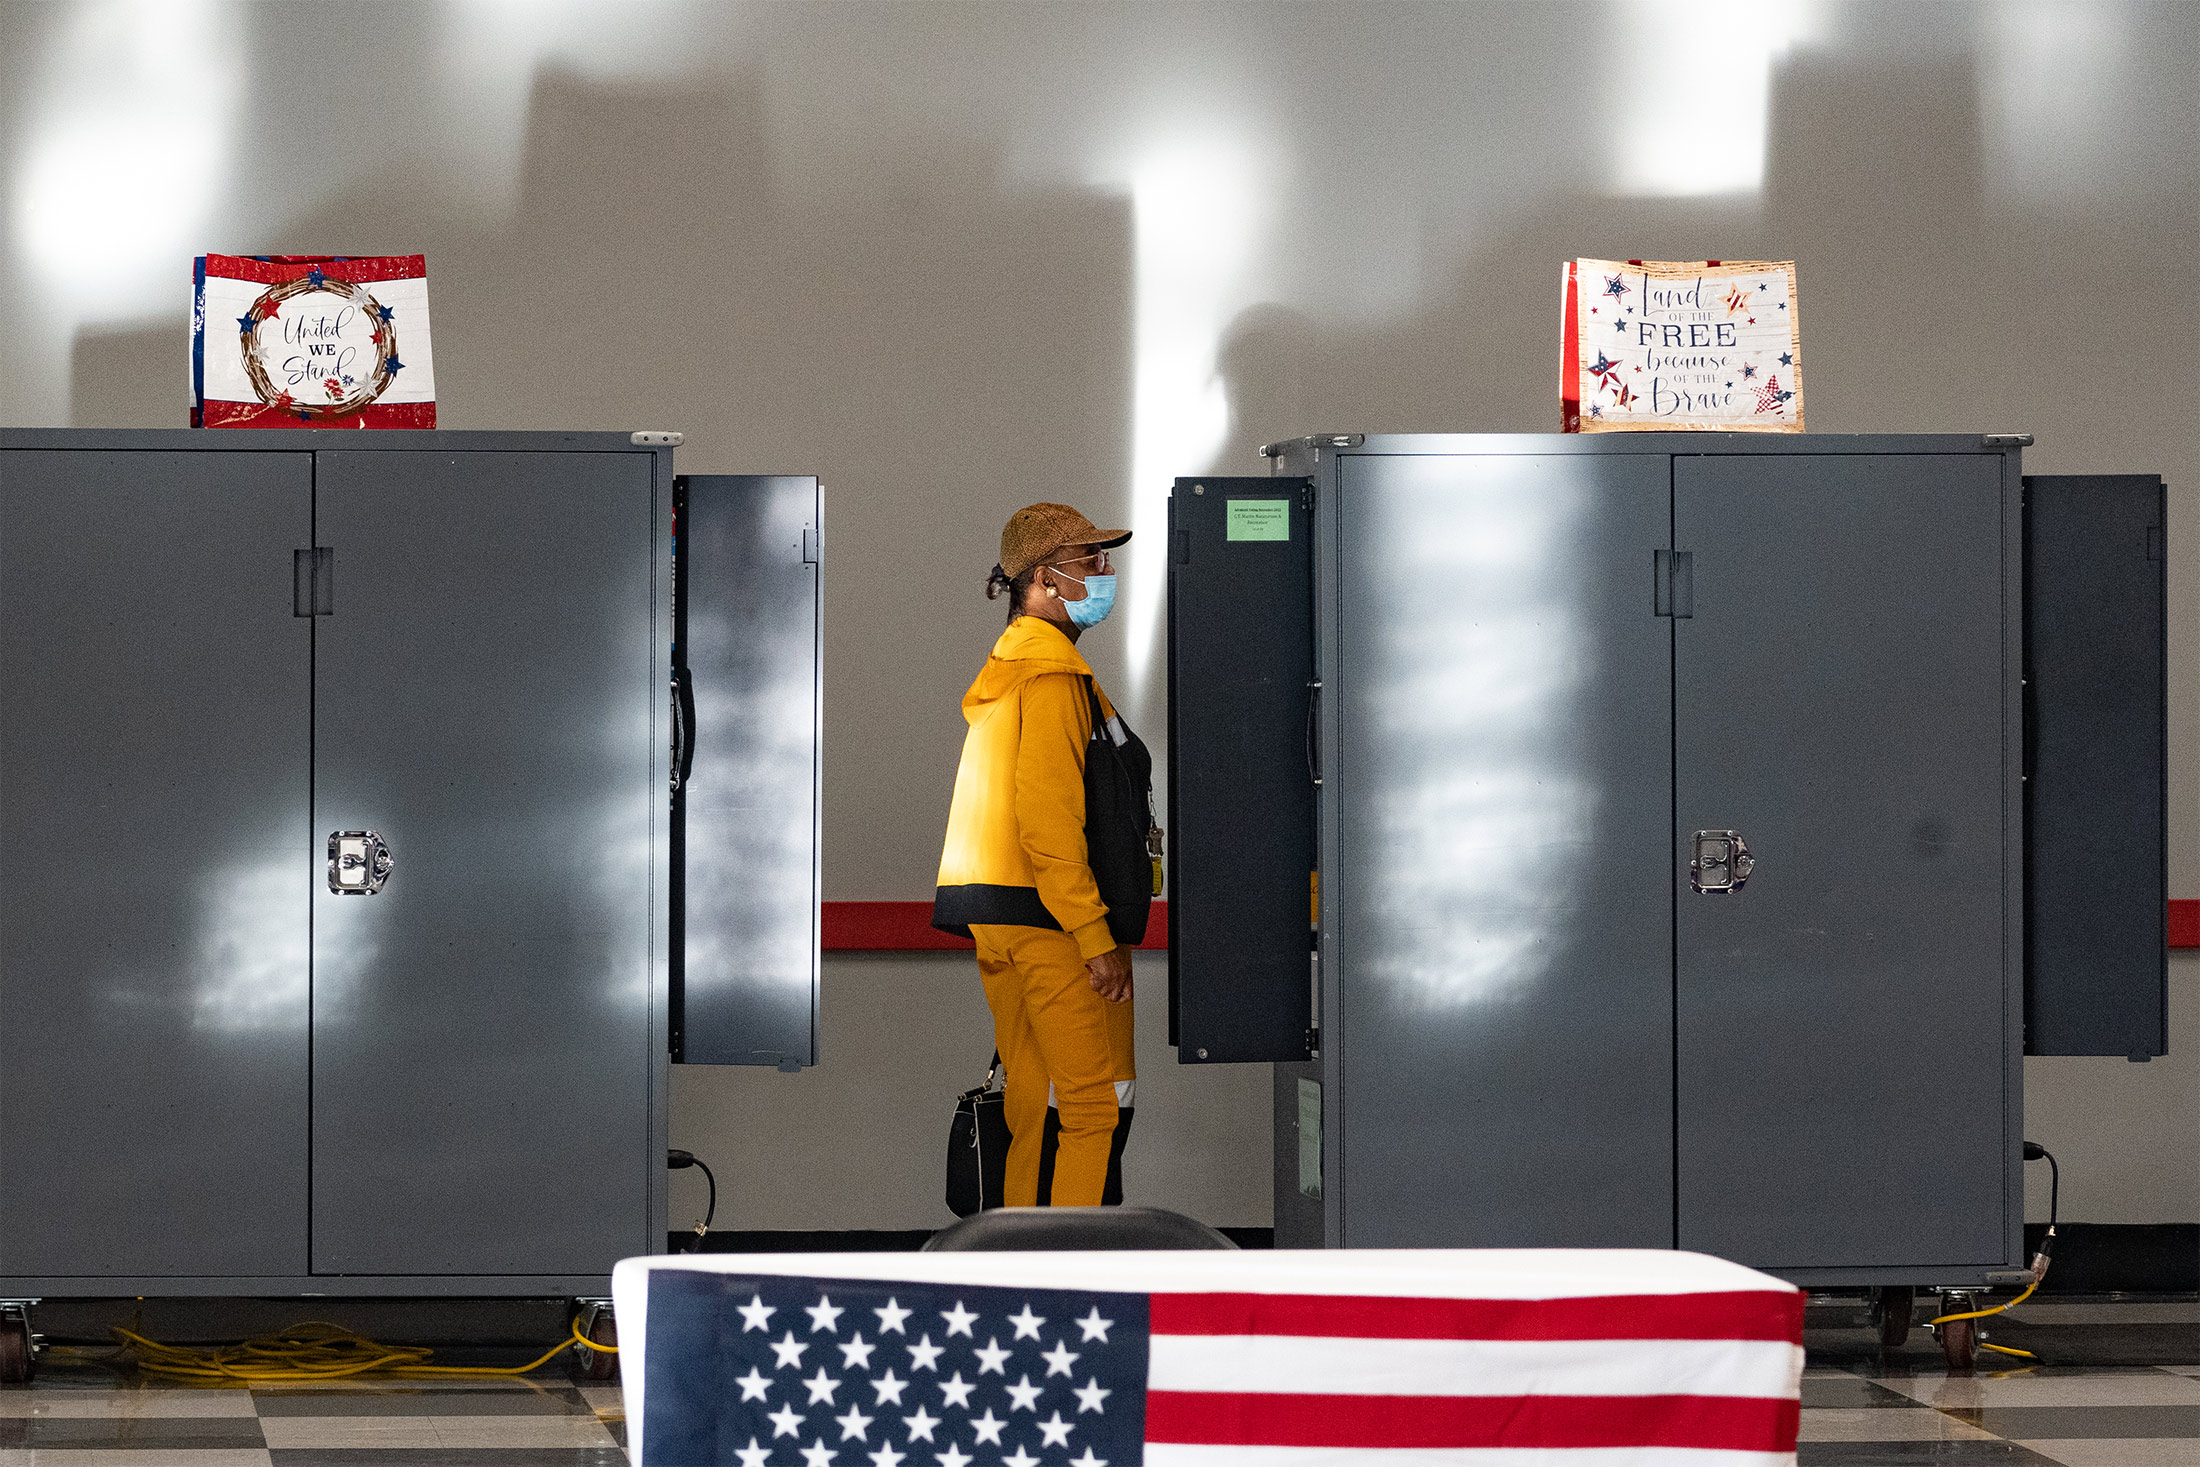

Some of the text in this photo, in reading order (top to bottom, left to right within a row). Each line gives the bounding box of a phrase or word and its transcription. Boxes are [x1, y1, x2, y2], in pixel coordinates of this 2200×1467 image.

[1643, 273, 1706, 317] Land
[284, 306, 355, 348] United
[1668, 312, 1714, 321] OF THE
[1638, 322, 1737, 348] FREE
[309, 344, 336, 356] WE
[1646, 348, 1730, 371] because
[282, 346, 356, 385] Stand
[1673, 373, 1719, 383] OF THE
[1649, 376, 1737, 417] Brave
